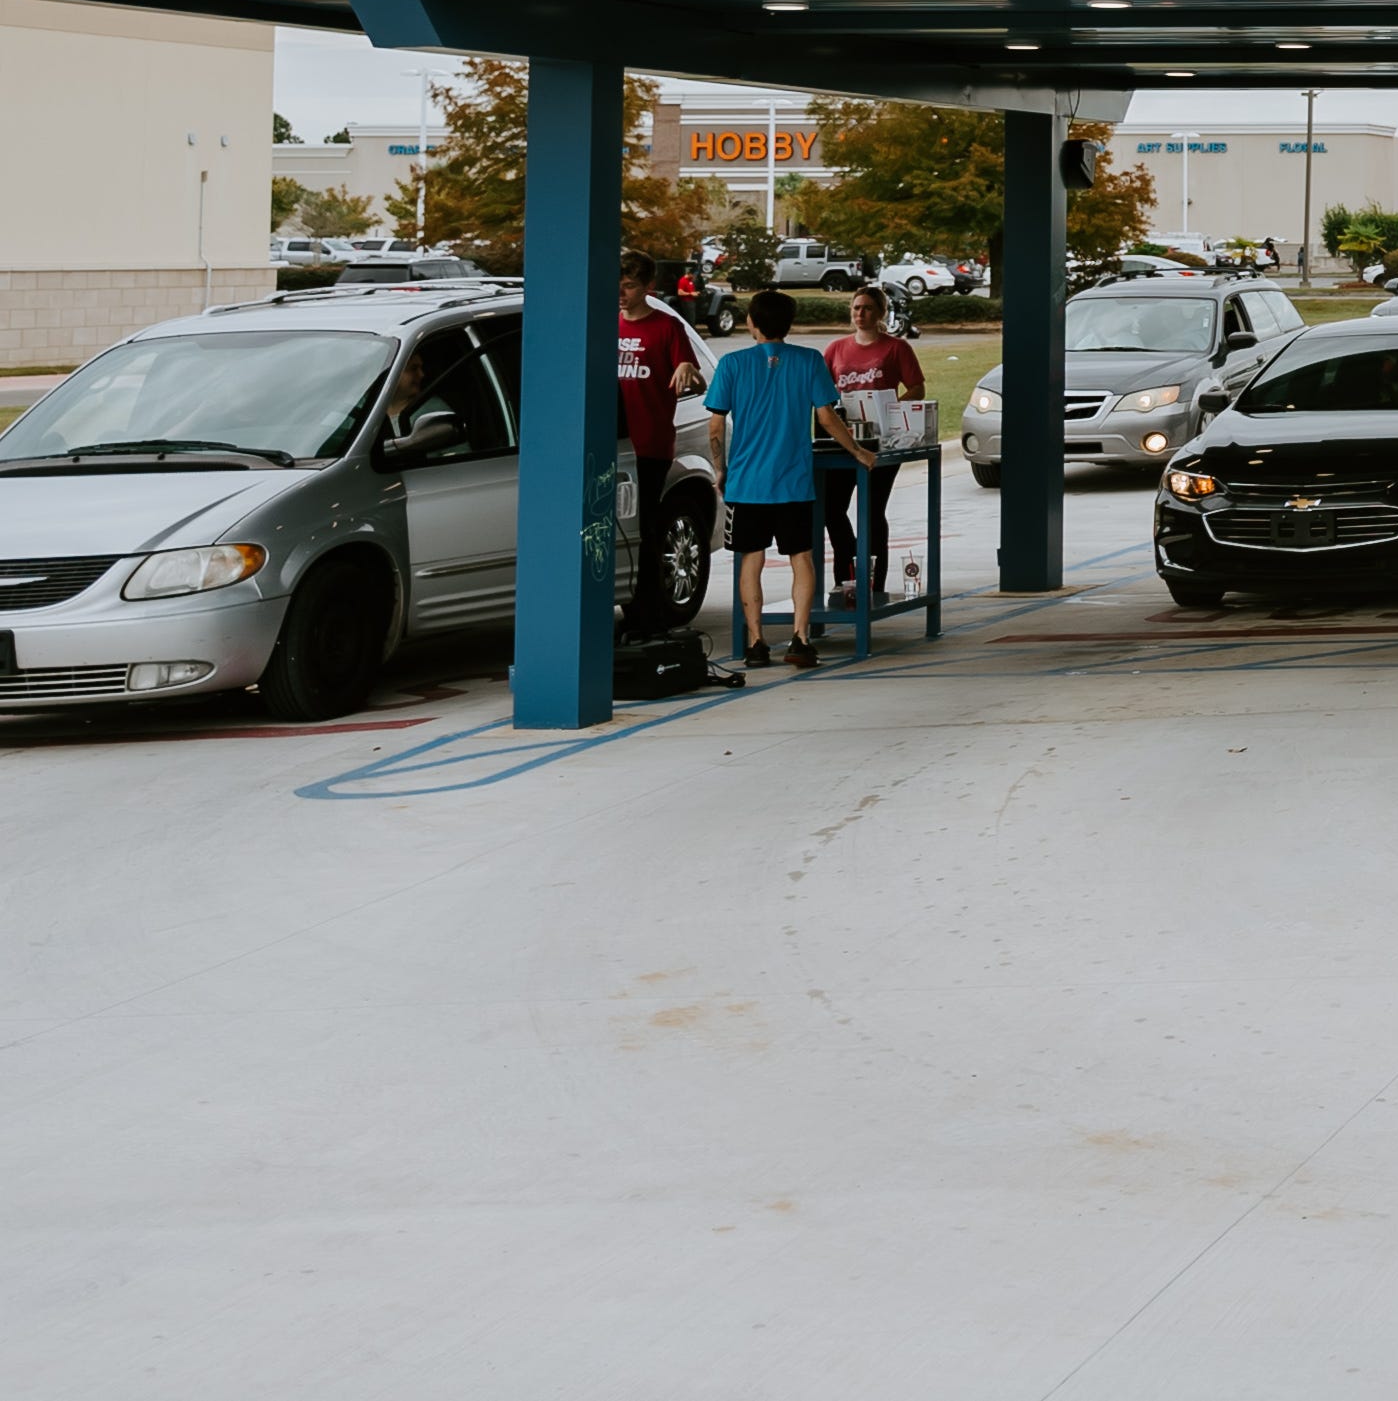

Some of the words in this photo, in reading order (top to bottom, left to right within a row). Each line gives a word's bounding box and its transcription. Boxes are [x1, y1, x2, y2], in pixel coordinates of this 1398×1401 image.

[690, 131, 817, 161] HOBBY
[1137, 142, 1161, 154] ART
[1166, 142, 1227, 154] SUPPLIES
